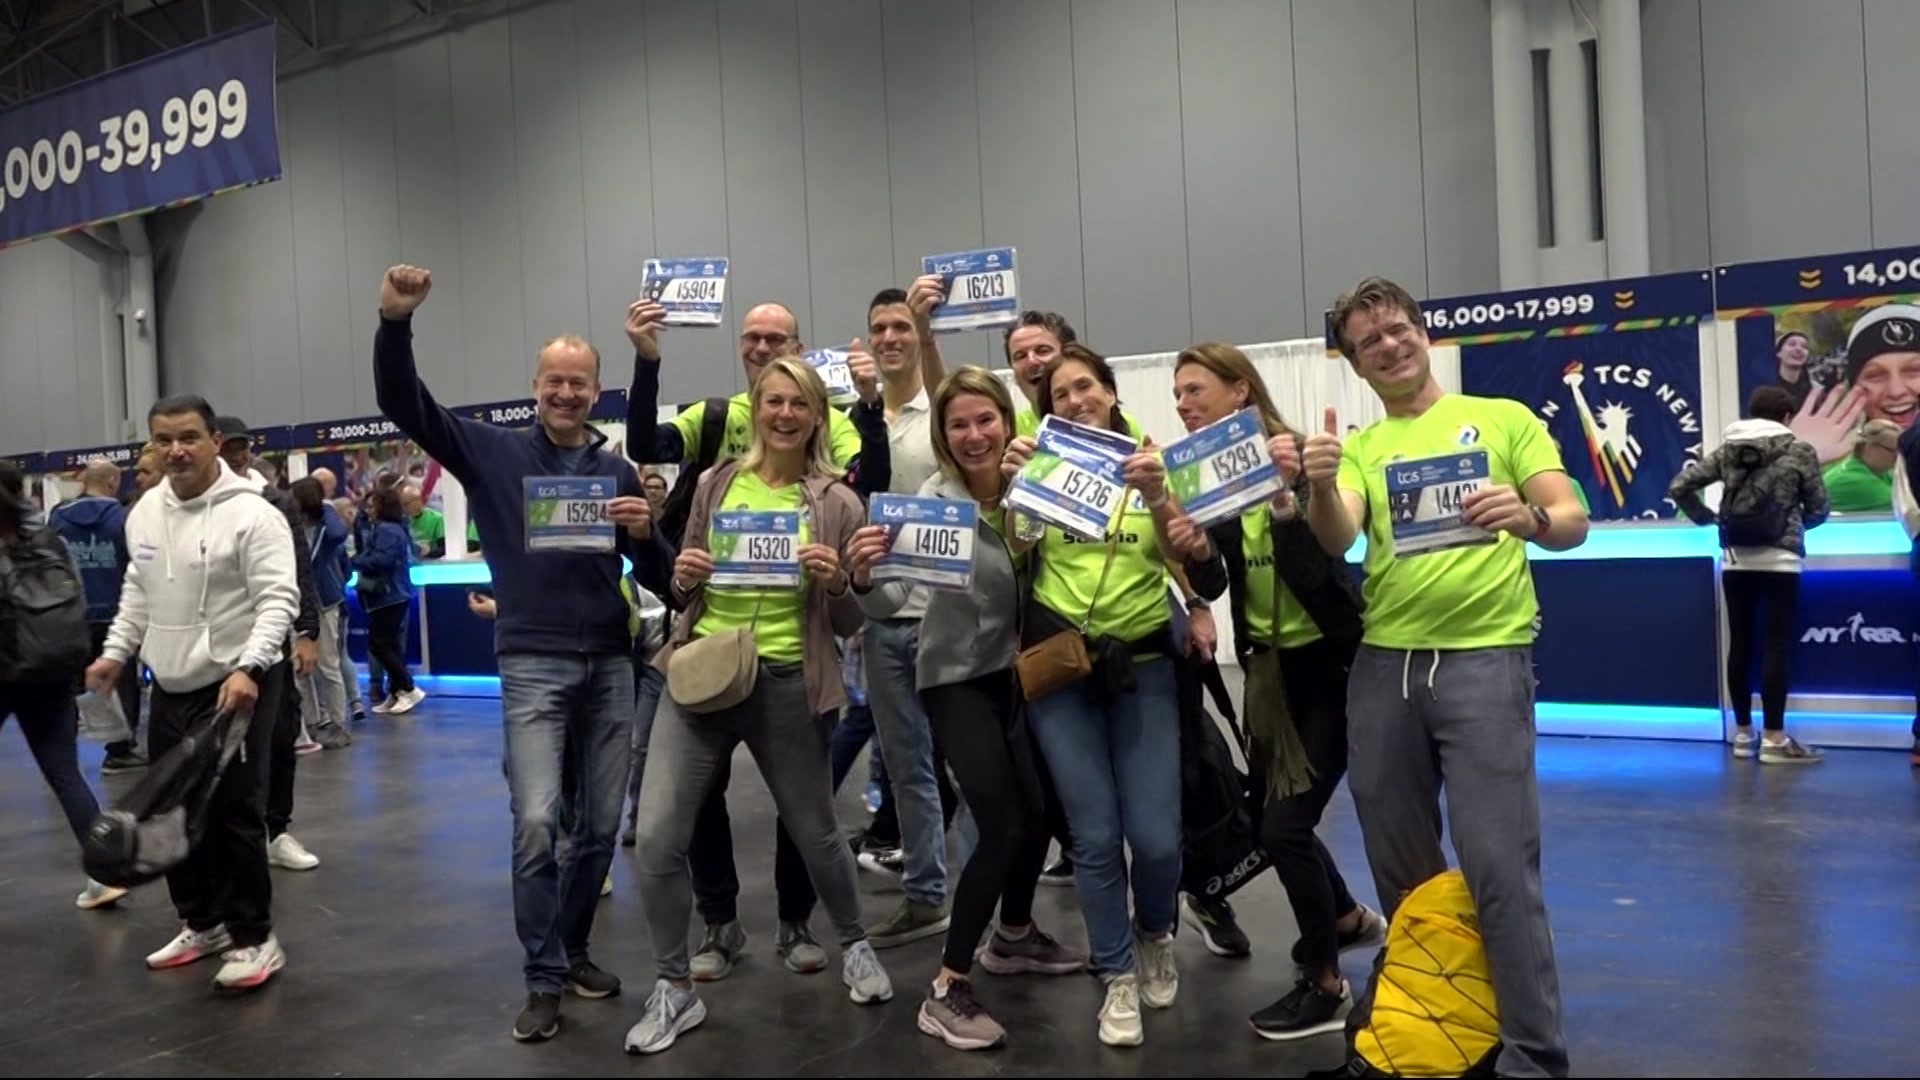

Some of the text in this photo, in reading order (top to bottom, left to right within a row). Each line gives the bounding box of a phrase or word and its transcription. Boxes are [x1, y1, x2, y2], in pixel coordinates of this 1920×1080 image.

[676, 280, 717, 300] 15904
[966, 273, 1005, 299] 16213
[1423, 294, 1595, 330] 16,000-17,999
[1593, 364, 1653, 389] TCS
[1655, 383, 1700, 434] NEW
[329, 421, 400, 440] 20,000-21,99
[1211, 441, 1261, 482] 15293
[1062, 469, 1112, 509] 15736
[567, 502, 607, 523] 15294
[748, 537, 791, 560] 15320
[915, 527, 960, 557] 14105
